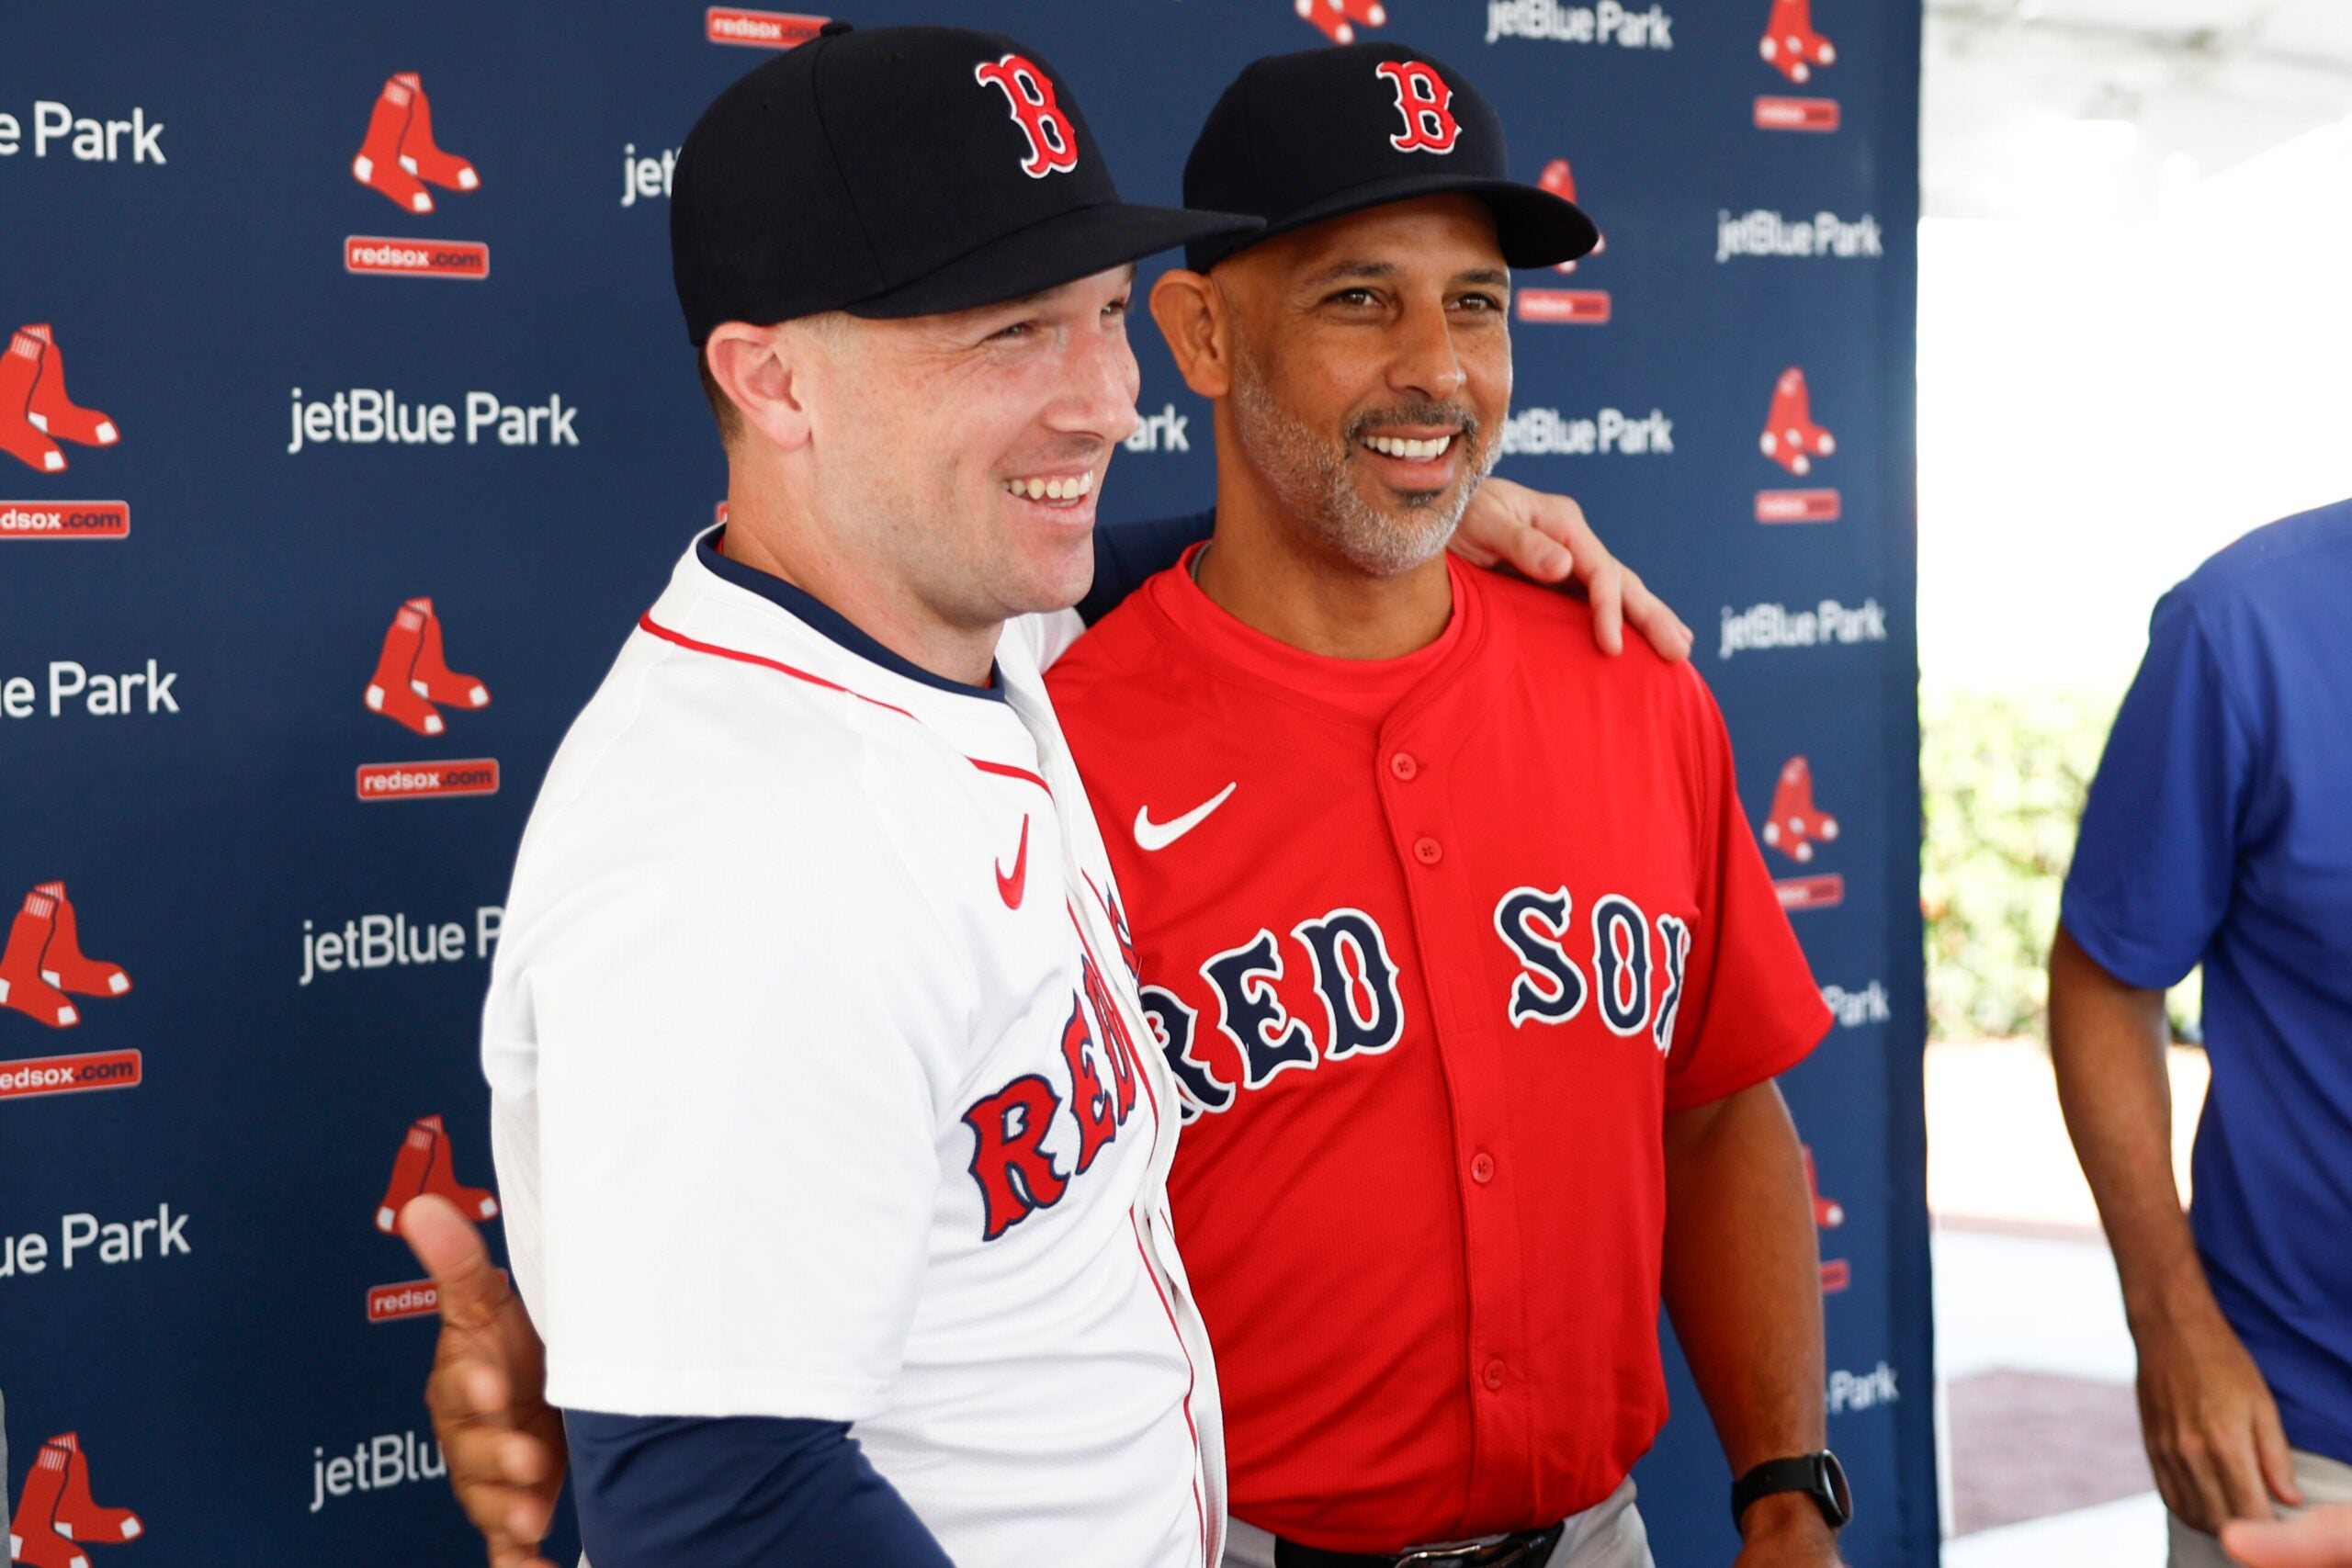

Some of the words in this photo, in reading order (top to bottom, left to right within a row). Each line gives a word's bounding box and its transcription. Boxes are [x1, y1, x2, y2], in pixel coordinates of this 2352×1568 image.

[1484, 0, 1595, 43] jetBlue
[1596, 0, 1675, 50] Park
[35, 100, 167, 164] Park
[974, 53, 1079, 179] B
[1375, 60, 1463, 154] B
[352, 244, 482, 268] redsox.com
[1814, 210, 1884, 258] Park
[288, 387, 457, 455] jetBlue
[466, 390, 580, 446] Park
[1124, 402, 1191, 452] ark
[1502, 407, 1597, 454] etBlue
[1598, 407, 1674, 454] Park
[0, 508, 121, 530] dsox.com
[1817, 598, 1888, 644] Park
[49, 658, 181, 717] Park
[364, 770, 492, 792] redsox.com
[299, 912, 467, 987] jetBlue
[0, 1062, 134, 1090] edsox.com
[961, 953, 1136, 1242] RED
[62, 1202, 192, 1270] Park
[375, 1289, 438, 1313] redso
[1830, 1359, 1900, 1415] Park
[310, 1430, 447, 1513] jetBlu
